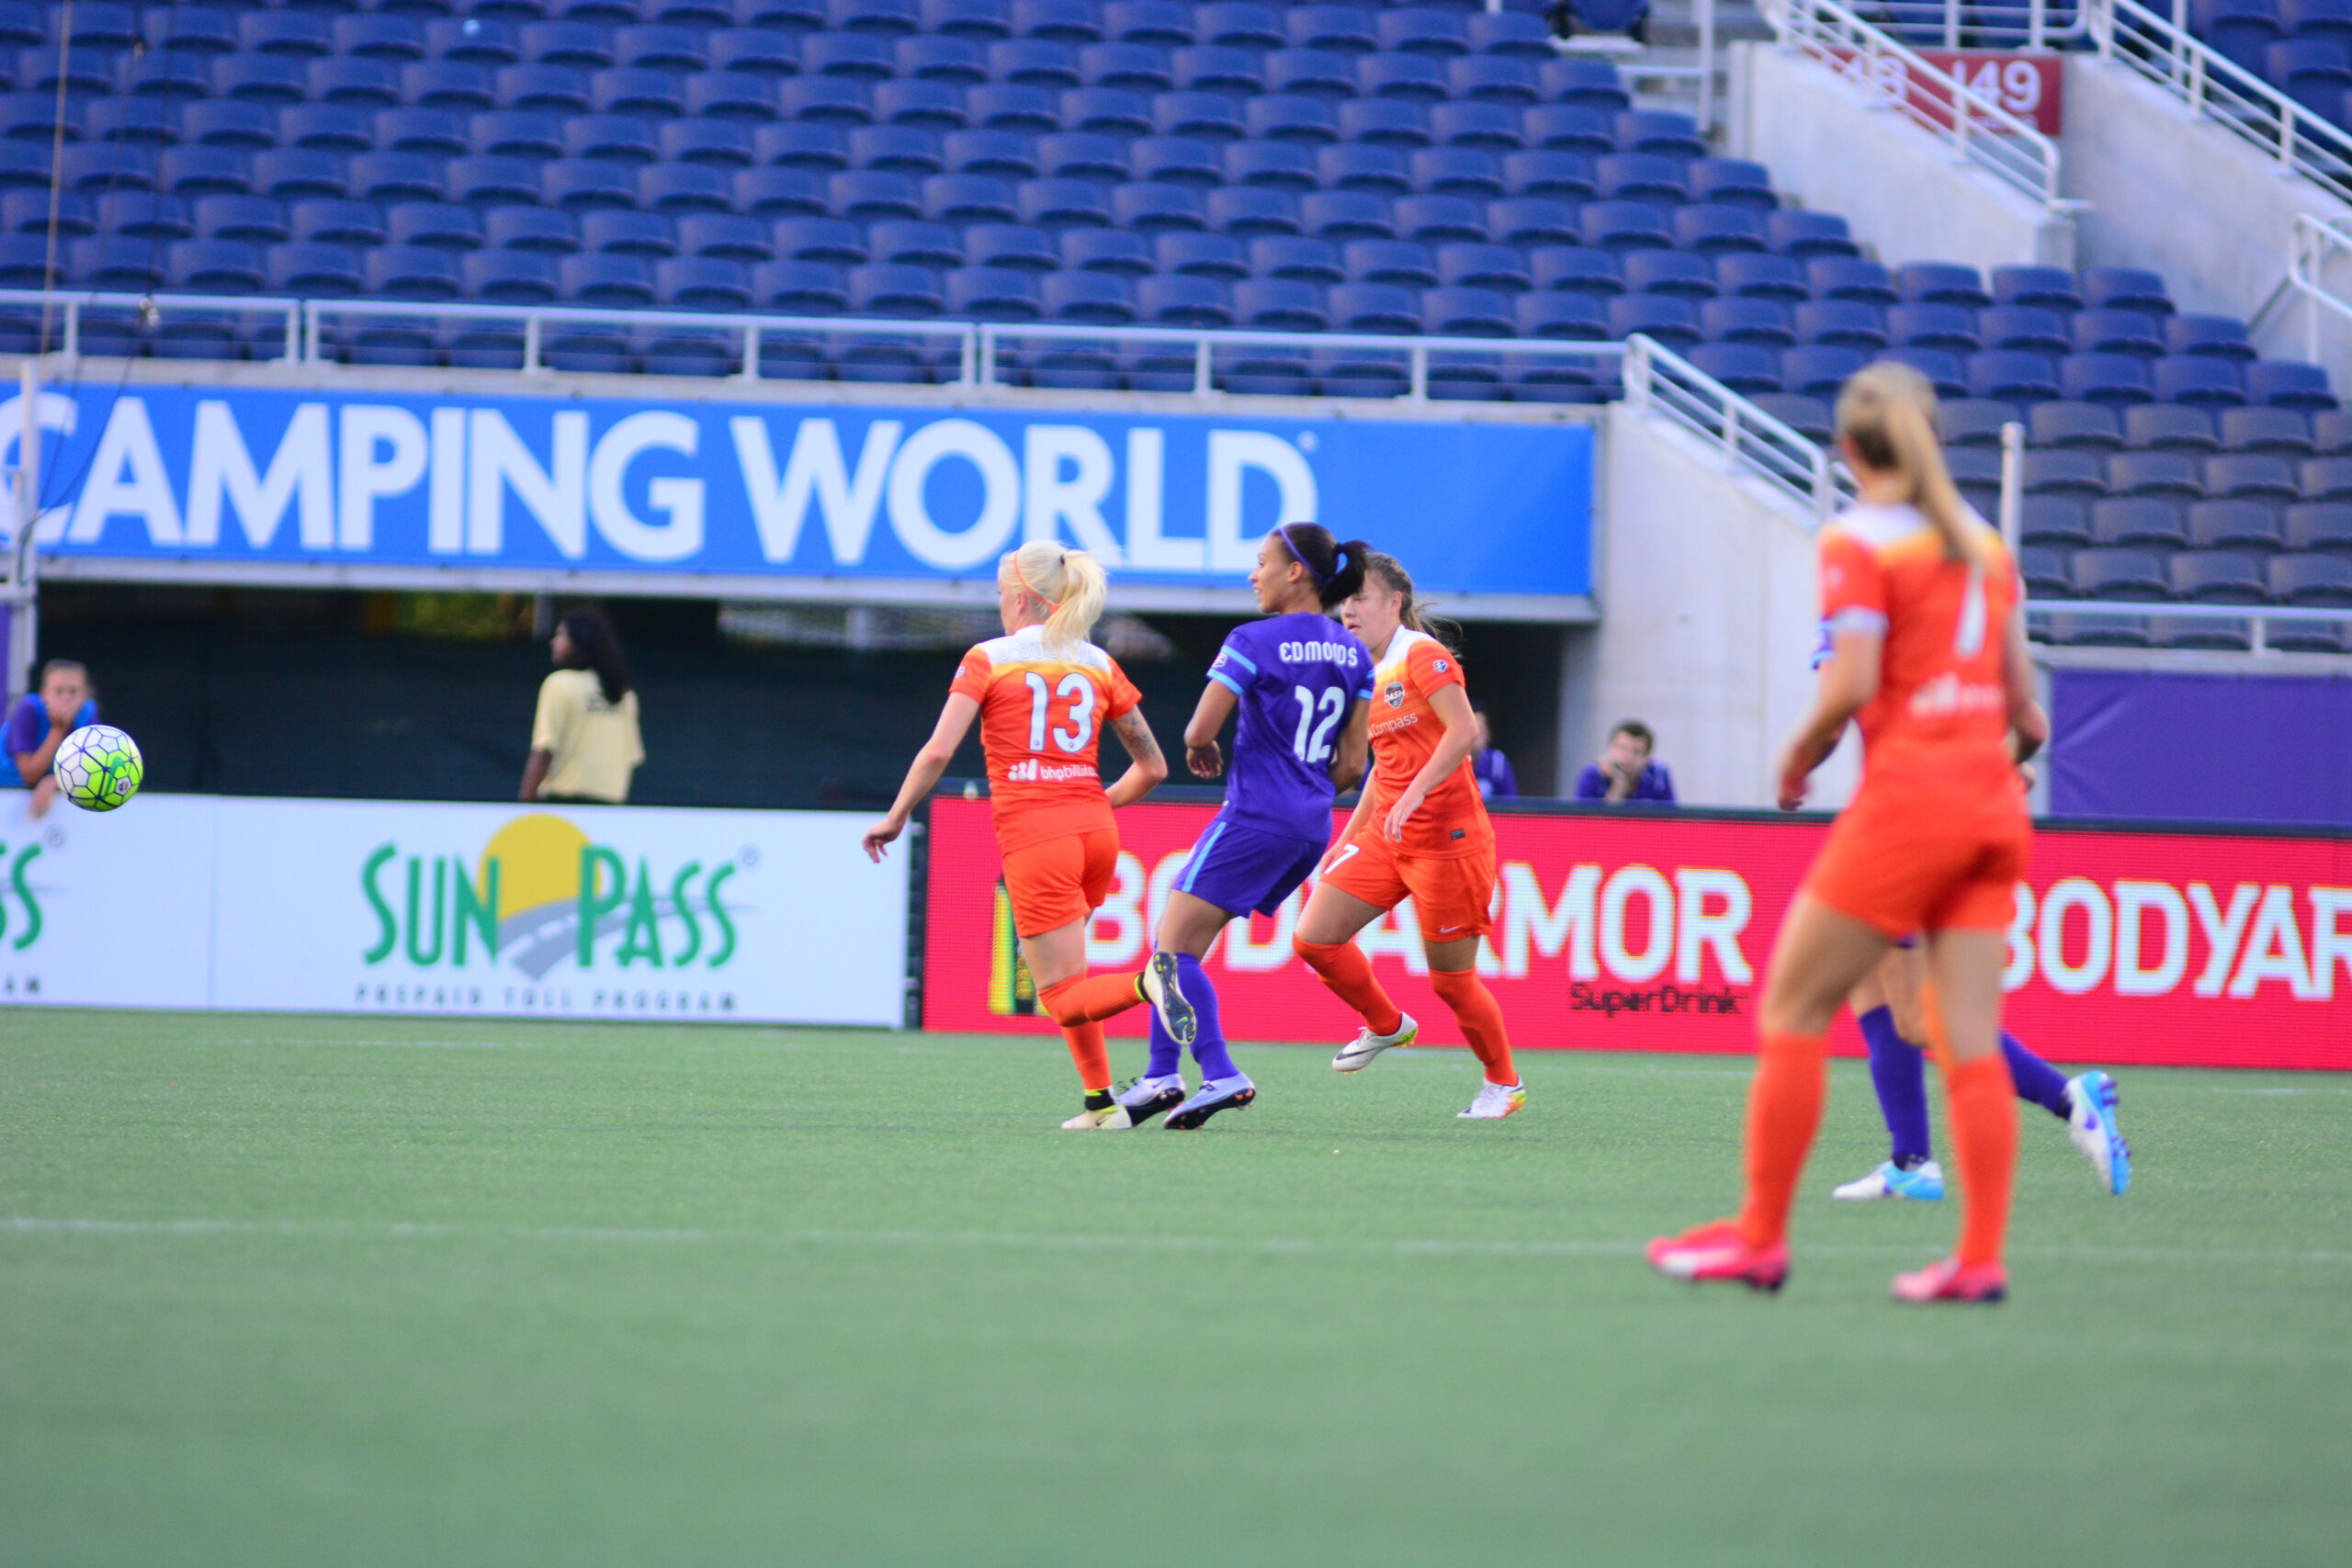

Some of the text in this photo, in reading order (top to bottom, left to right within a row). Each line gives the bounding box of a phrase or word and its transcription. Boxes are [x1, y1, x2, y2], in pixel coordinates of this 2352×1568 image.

[0, 392, 1317, 572] CAMPING WORLD
[1024, 671, 1094, 753] 13
[1294, 684, 1346, 763] 12
[1384, 689, 1406, 703] DASH
[360, 840, 738, 969] SUN PASS
[1082, 850, 1755, 985] BDAMOR
[355, 984, 736, 1012] PREPAID TOLL PROGRAM
